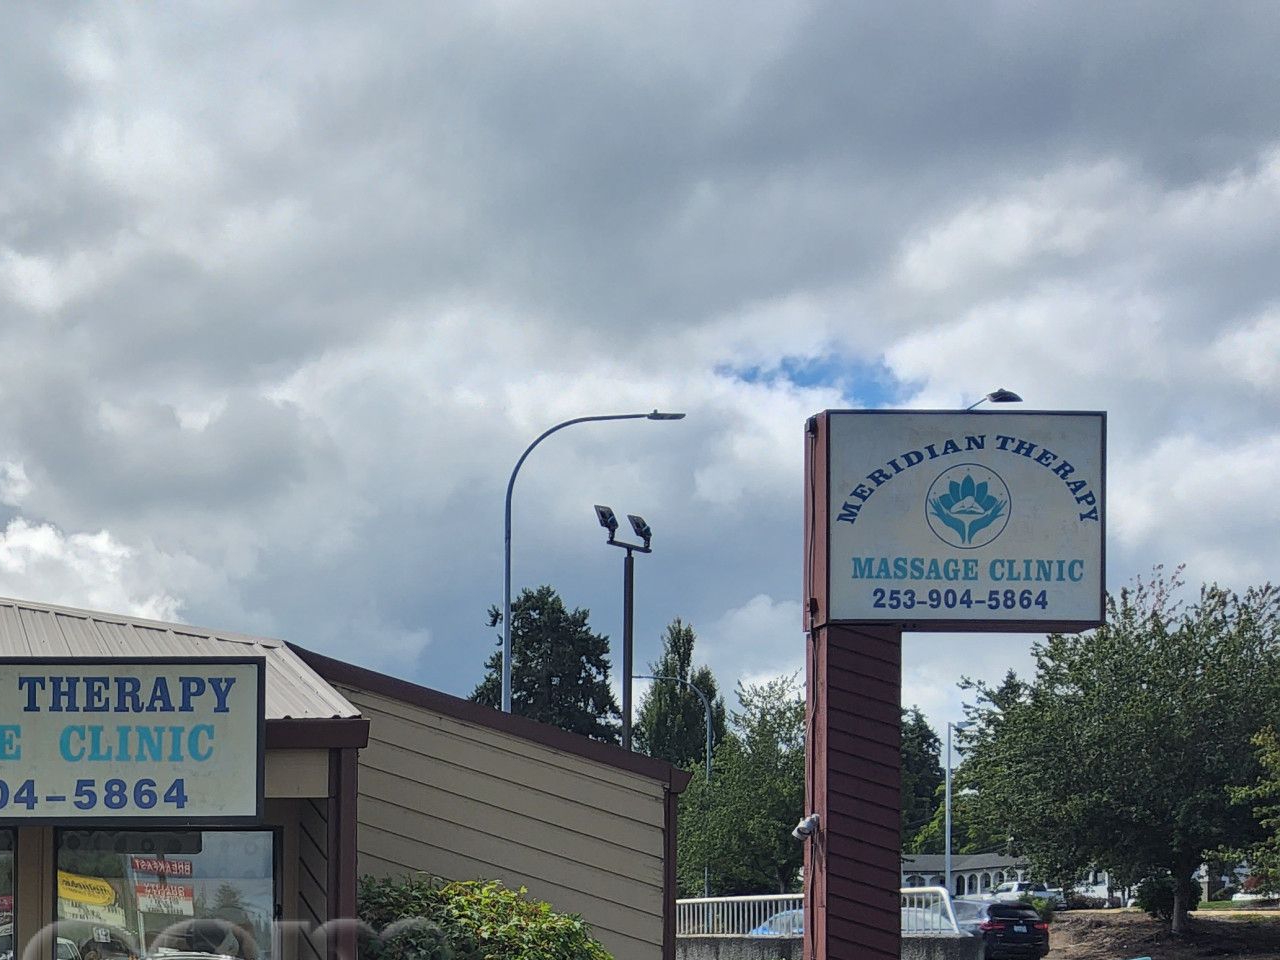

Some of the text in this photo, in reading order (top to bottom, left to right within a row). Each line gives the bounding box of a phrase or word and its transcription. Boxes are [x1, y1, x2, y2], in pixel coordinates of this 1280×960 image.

[836, 434, 1099, 524] MERIDIAN THERAPY
[851, 557, 1085, 582] MASSAGE CLINIC
[872, 587, 1048, 610] 253-904-5864
[19, 676, 236, 713] THERAPY
[59, 724, 216, 762] CLINIC
